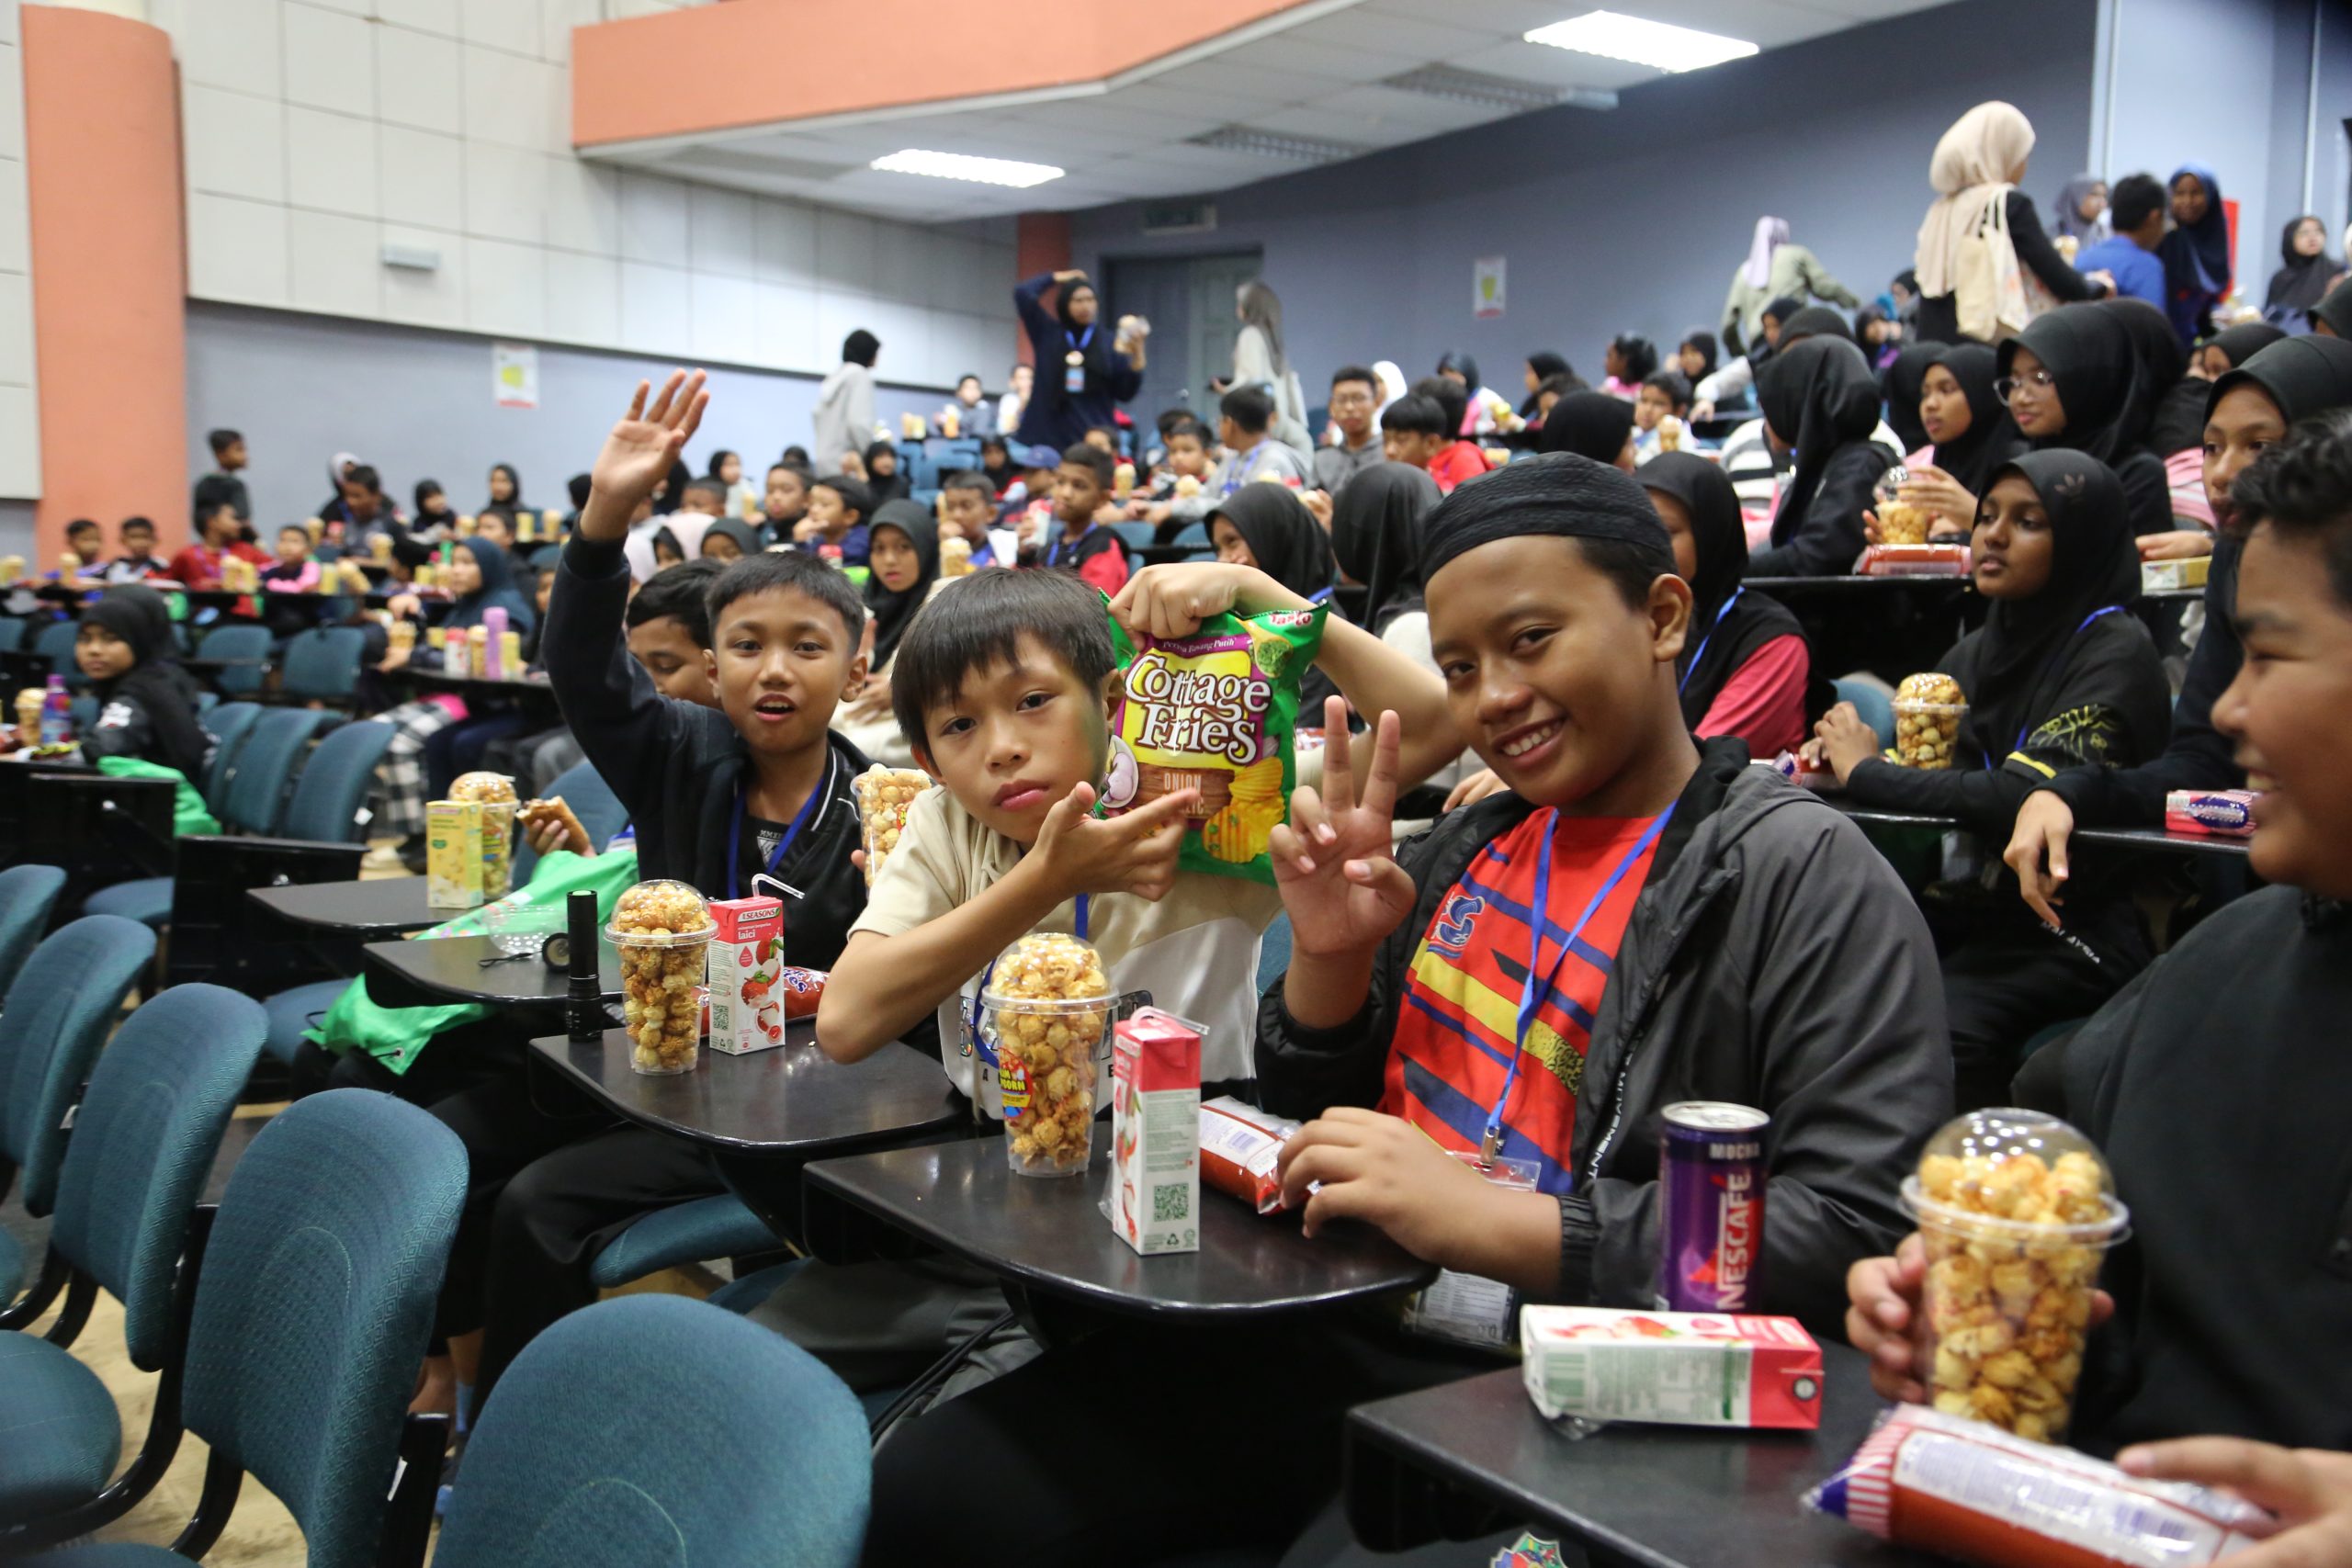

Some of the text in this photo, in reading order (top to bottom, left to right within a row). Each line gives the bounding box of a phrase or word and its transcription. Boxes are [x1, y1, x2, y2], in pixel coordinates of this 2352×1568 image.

[1125, 655, 1272, 723] Cottage
[1136, 704, 1258, 764] Fries
[1164, 773, 1202, 794] ONION
[746, 908, 775, 919] SEASONS
[738, 929, 756, 940] laici
[1588, 1071, 1626, 1180] MOVEMENT
